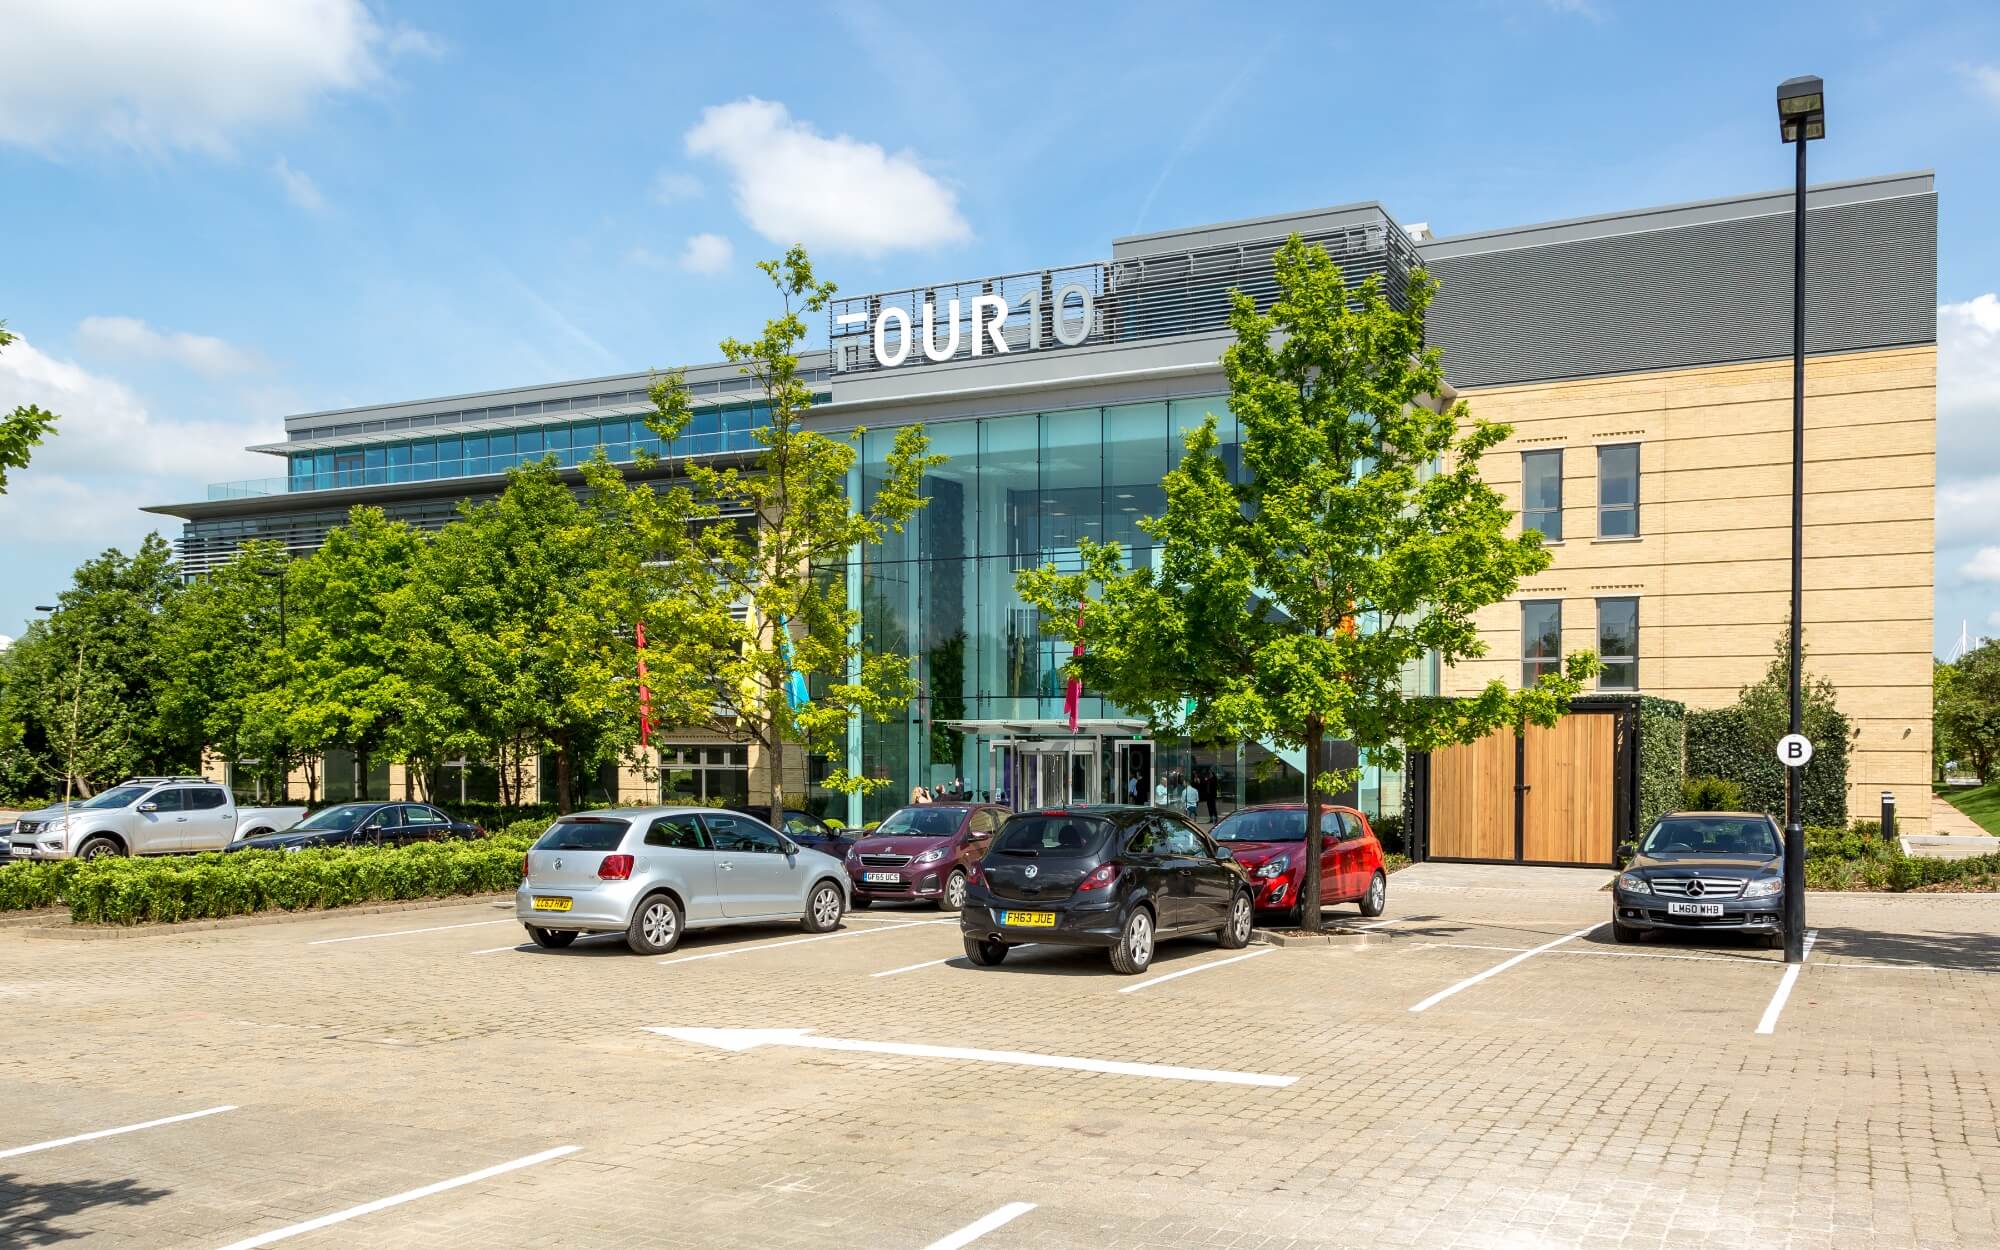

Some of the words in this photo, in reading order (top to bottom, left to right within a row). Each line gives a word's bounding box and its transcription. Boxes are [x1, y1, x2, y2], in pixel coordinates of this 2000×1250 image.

[1788, 742, 1802, 758] B
[868, 873, 885, 881] GF65
[886, 873, 898, 881] UCS
[1672, 903, 1697, 914] LM60
[1007, 912, 1031, 923] FH63
[1034, 913, 1053, 924] JUE
